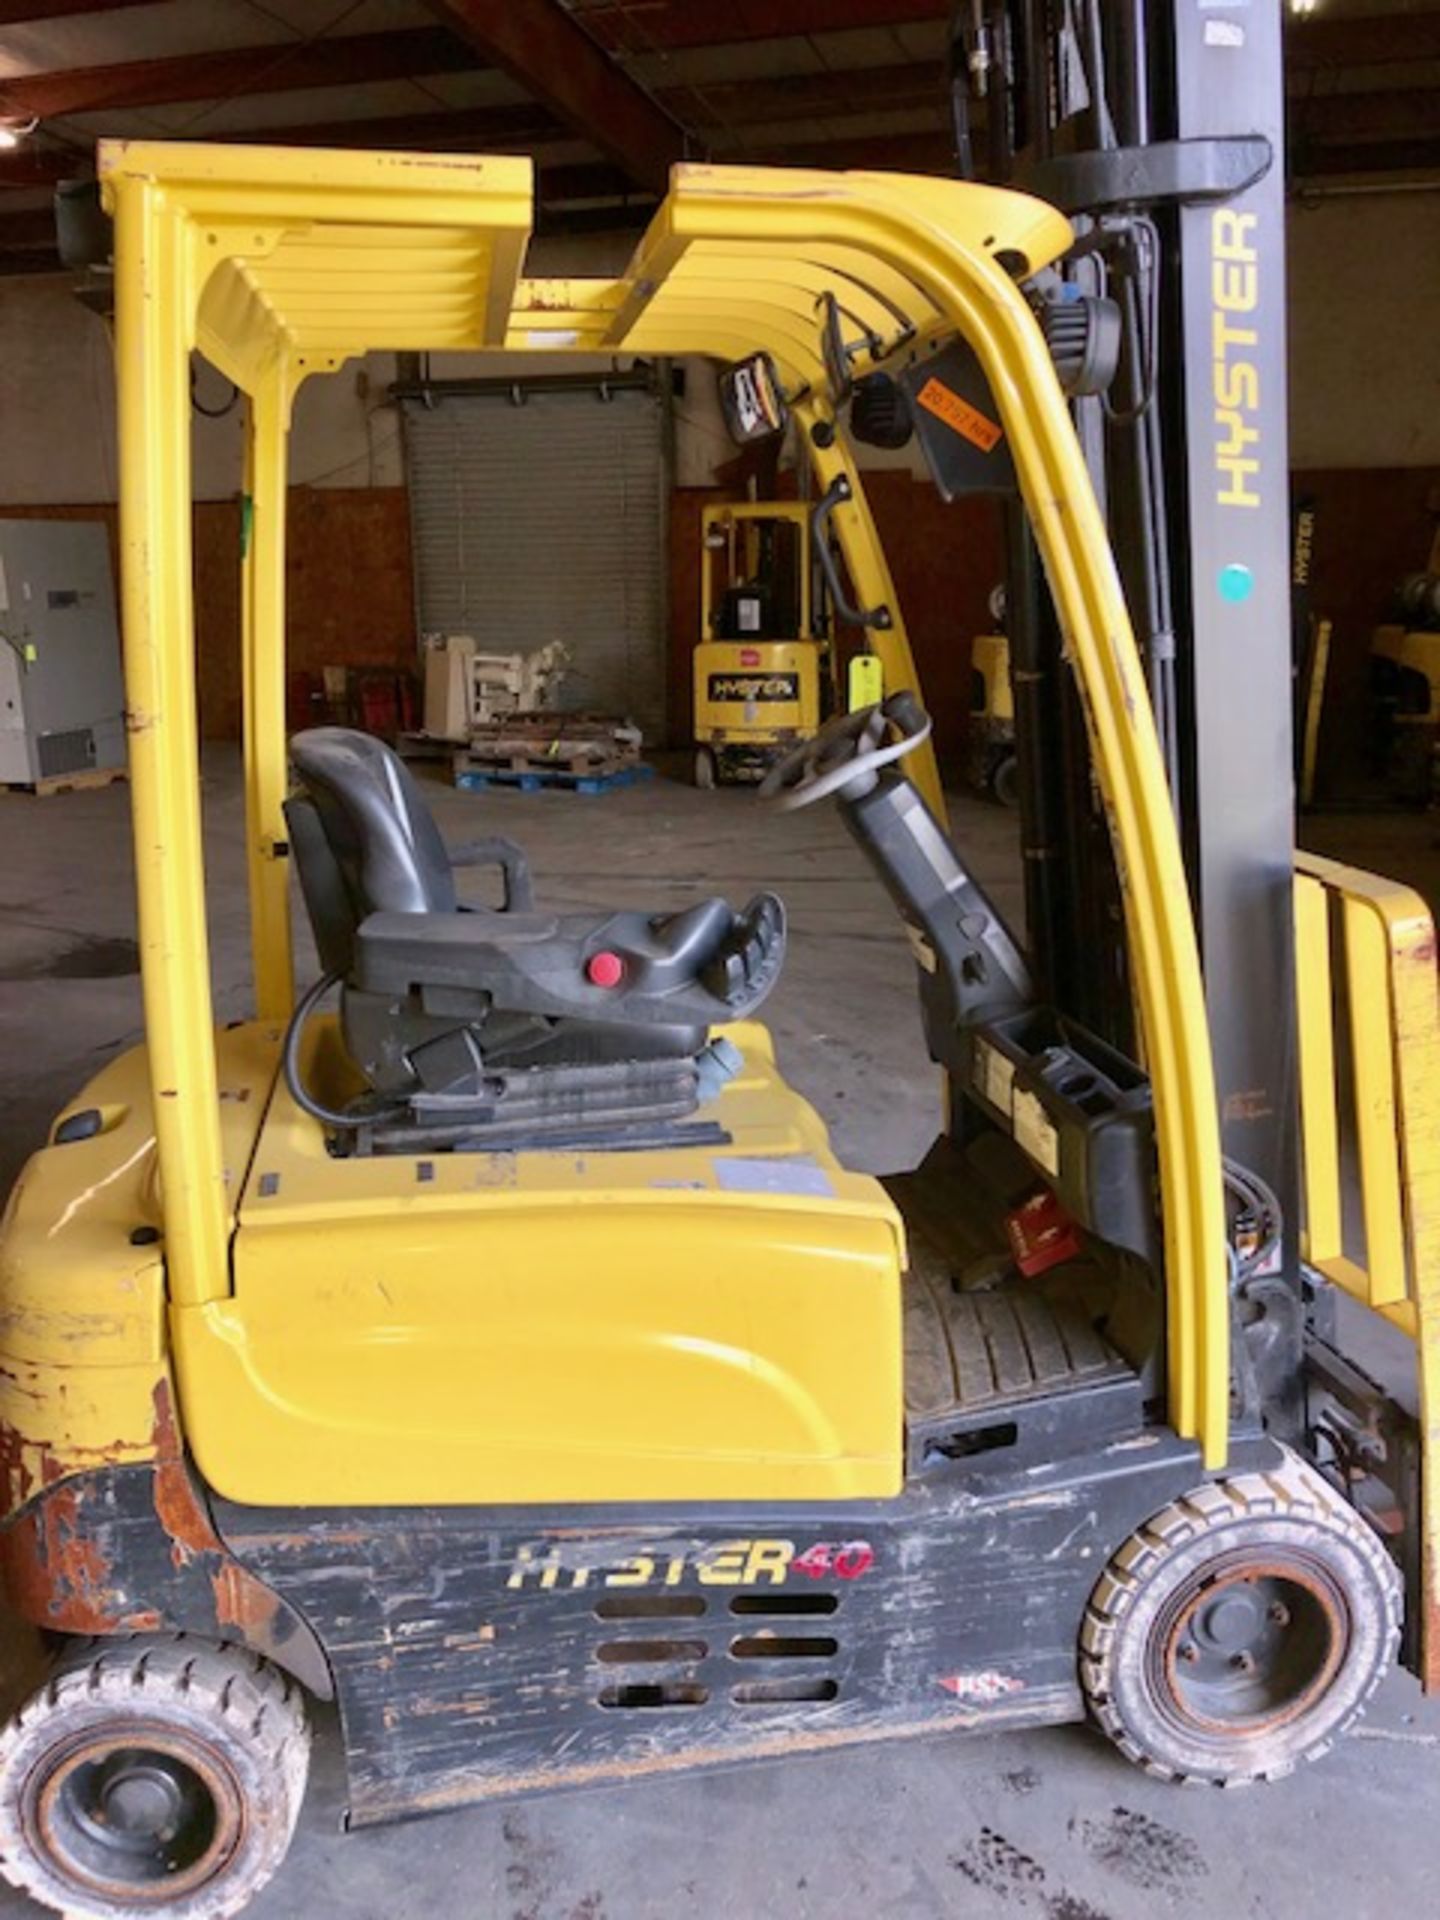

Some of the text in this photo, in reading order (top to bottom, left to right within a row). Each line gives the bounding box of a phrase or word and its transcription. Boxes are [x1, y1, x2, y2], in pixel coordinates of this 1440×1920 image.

[1212, 208, 1260, 508] HYSTER
[1294, 512, 1314, 585] HYSTER
[714, 679, 793, 697] HYSTER
[792, 1540, 874, 1580] 40
